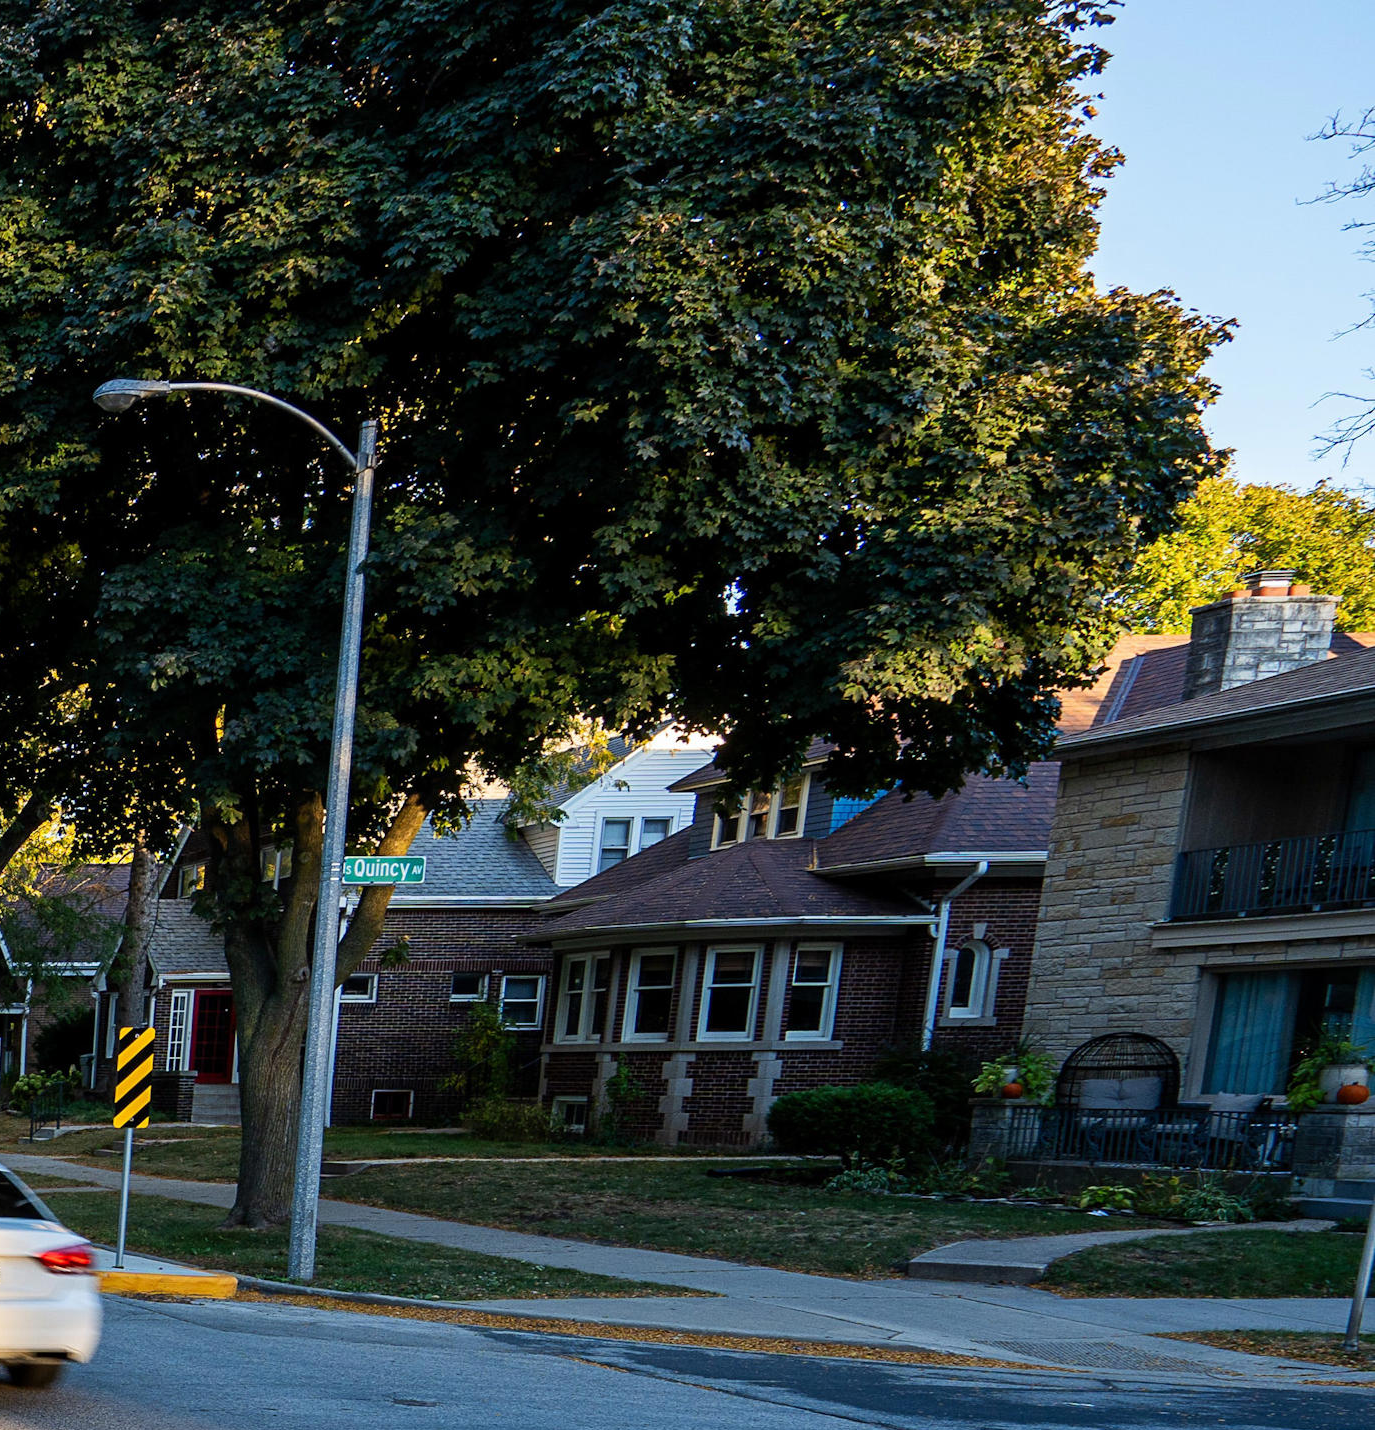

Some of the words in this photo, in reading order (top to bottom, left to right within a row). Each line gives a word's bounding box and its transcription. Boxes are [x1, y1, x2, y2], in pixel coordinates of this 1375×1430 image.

[346, 865, 352, 875] S
[354, 859, 410, 881] Quincy
[411, 865, 423, 875] AV
